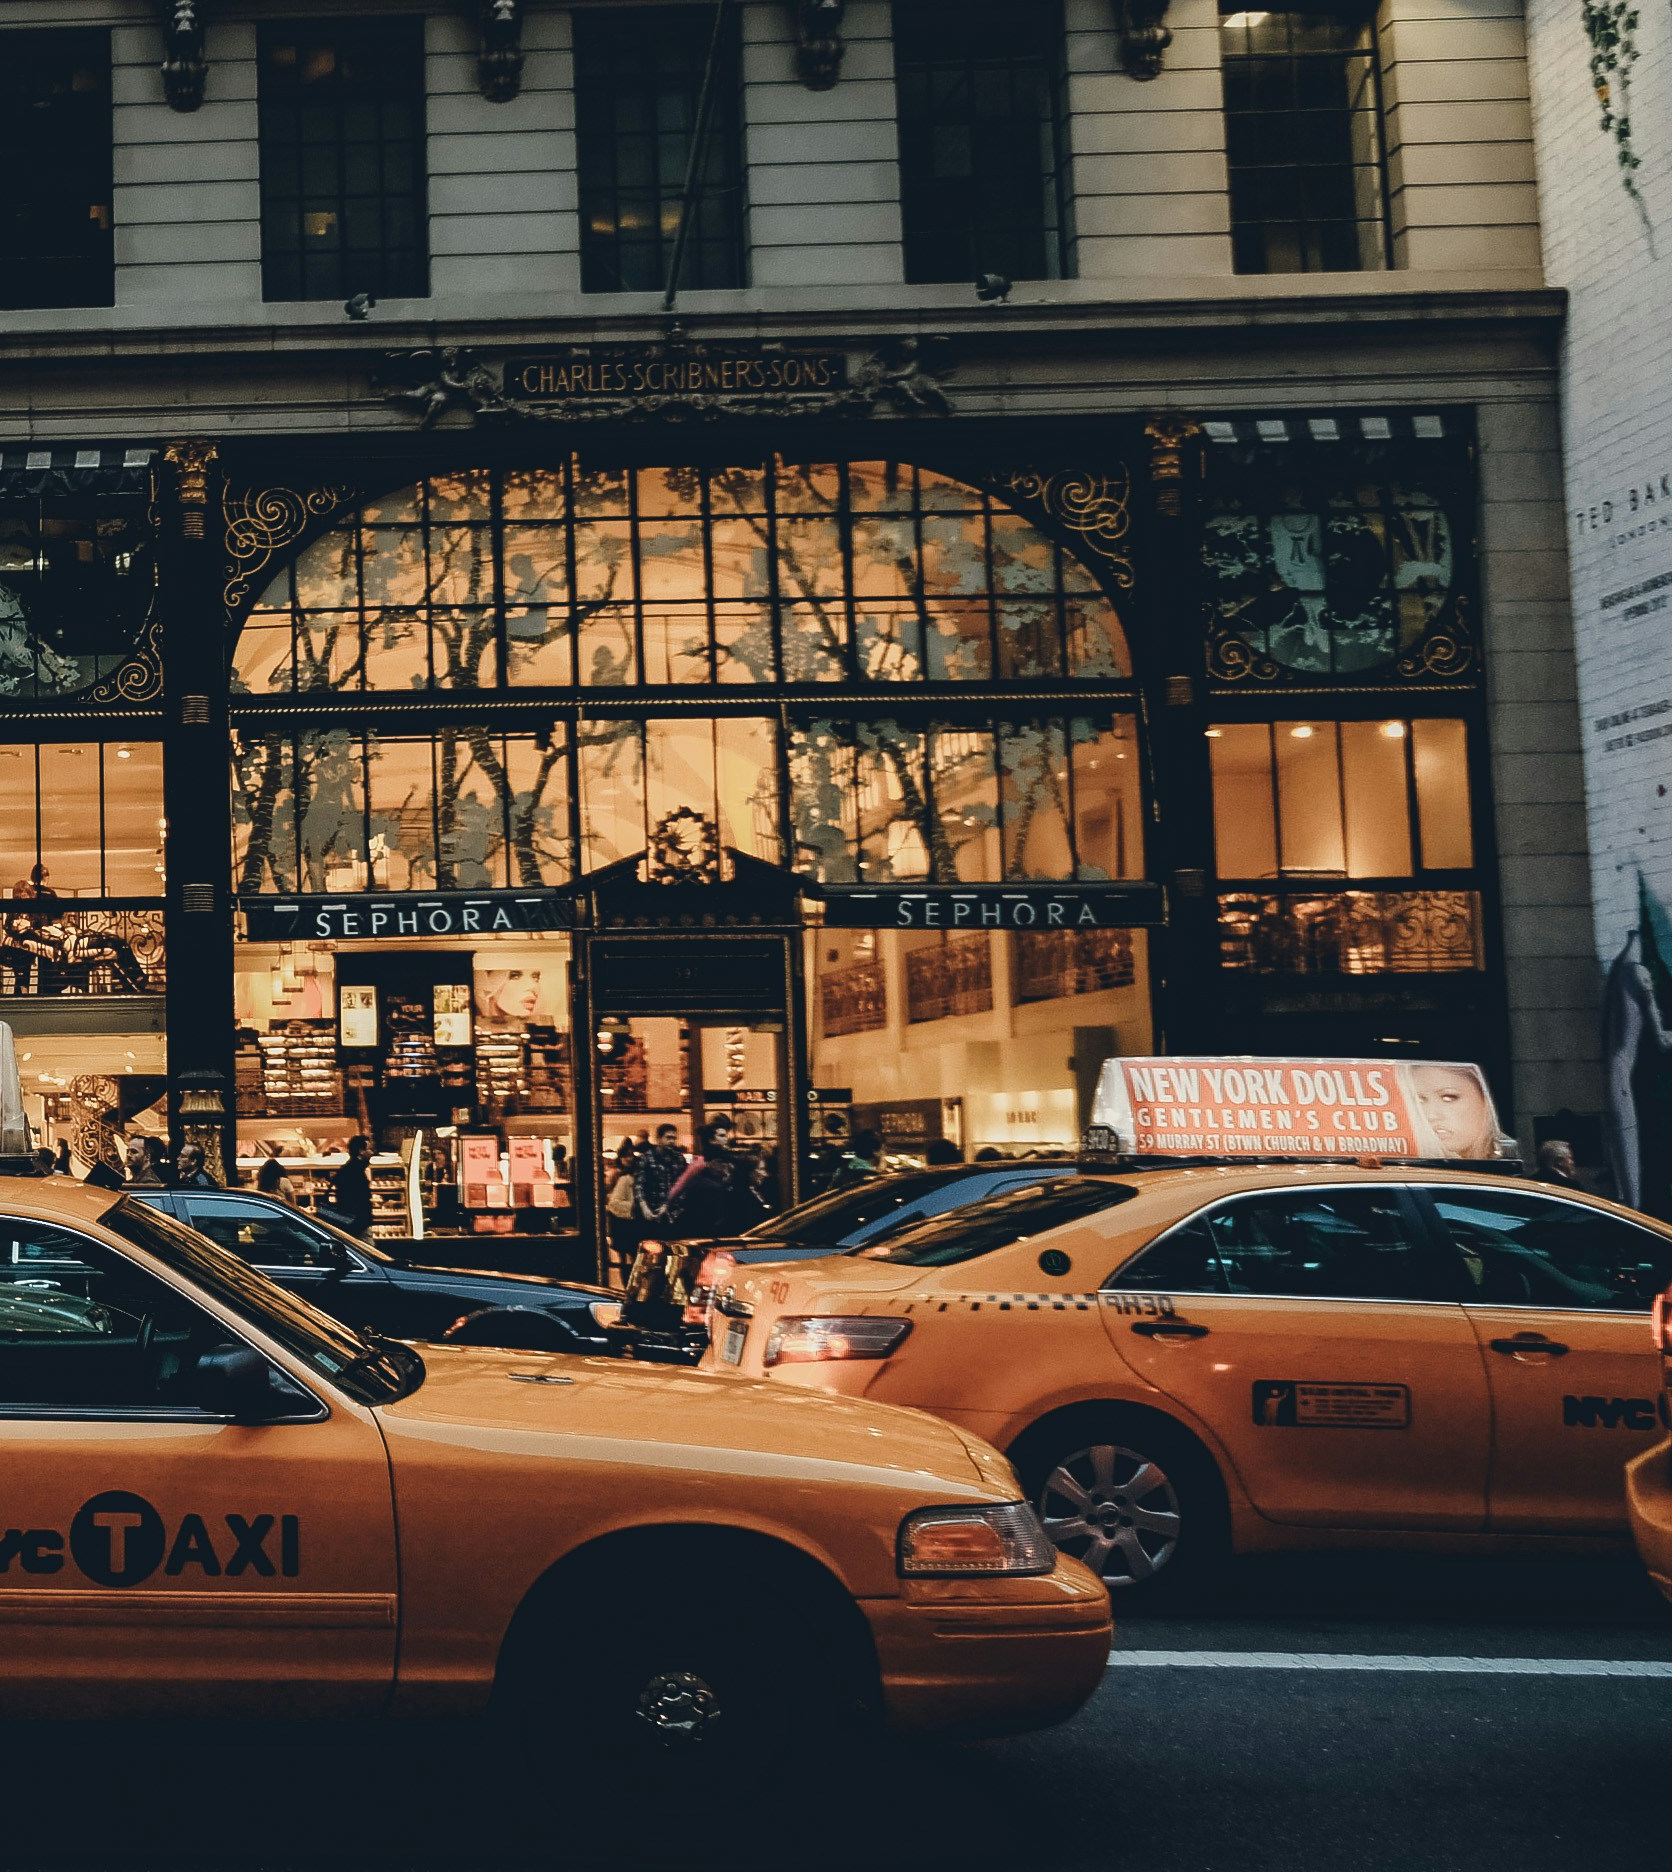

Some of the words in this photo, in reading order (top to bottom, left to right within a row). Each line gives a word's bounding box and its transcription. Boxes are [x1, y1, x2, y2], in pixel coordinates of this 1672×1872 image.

[316, 907, 513, 937] SEPHORA
[897, 900, 1097, 926] SEPHORA
[1128, 1067, 1201, 1103] NEW
[1201, 1068, 1290, 1104] YORK
[1291, 1069, 1390, 1107] DOLLS
[1137, 1107, 1320, 1130] GENTLEMEN'S
[1332, 1110, 1399, 1132] CLUB
[1139, 1134, 1154, 1150] 59
[1156, 1134, 1204, 1150] MURRAY
[1207, 1134, 1221, 1150] ST
[1224, 1134, 1262, 1153] (BTWN
[1264, 1135, 1311, 1152] CHURCH
[1313, 1136, 1323, 1152] &
[1324, 1136, 1336, 1152] W
[1339, 1136, 1408, 1155] BROADWAY)
[1563, 1394, 1656, 1431] NYC
[78, 1500, 300, 1580] TAXI
